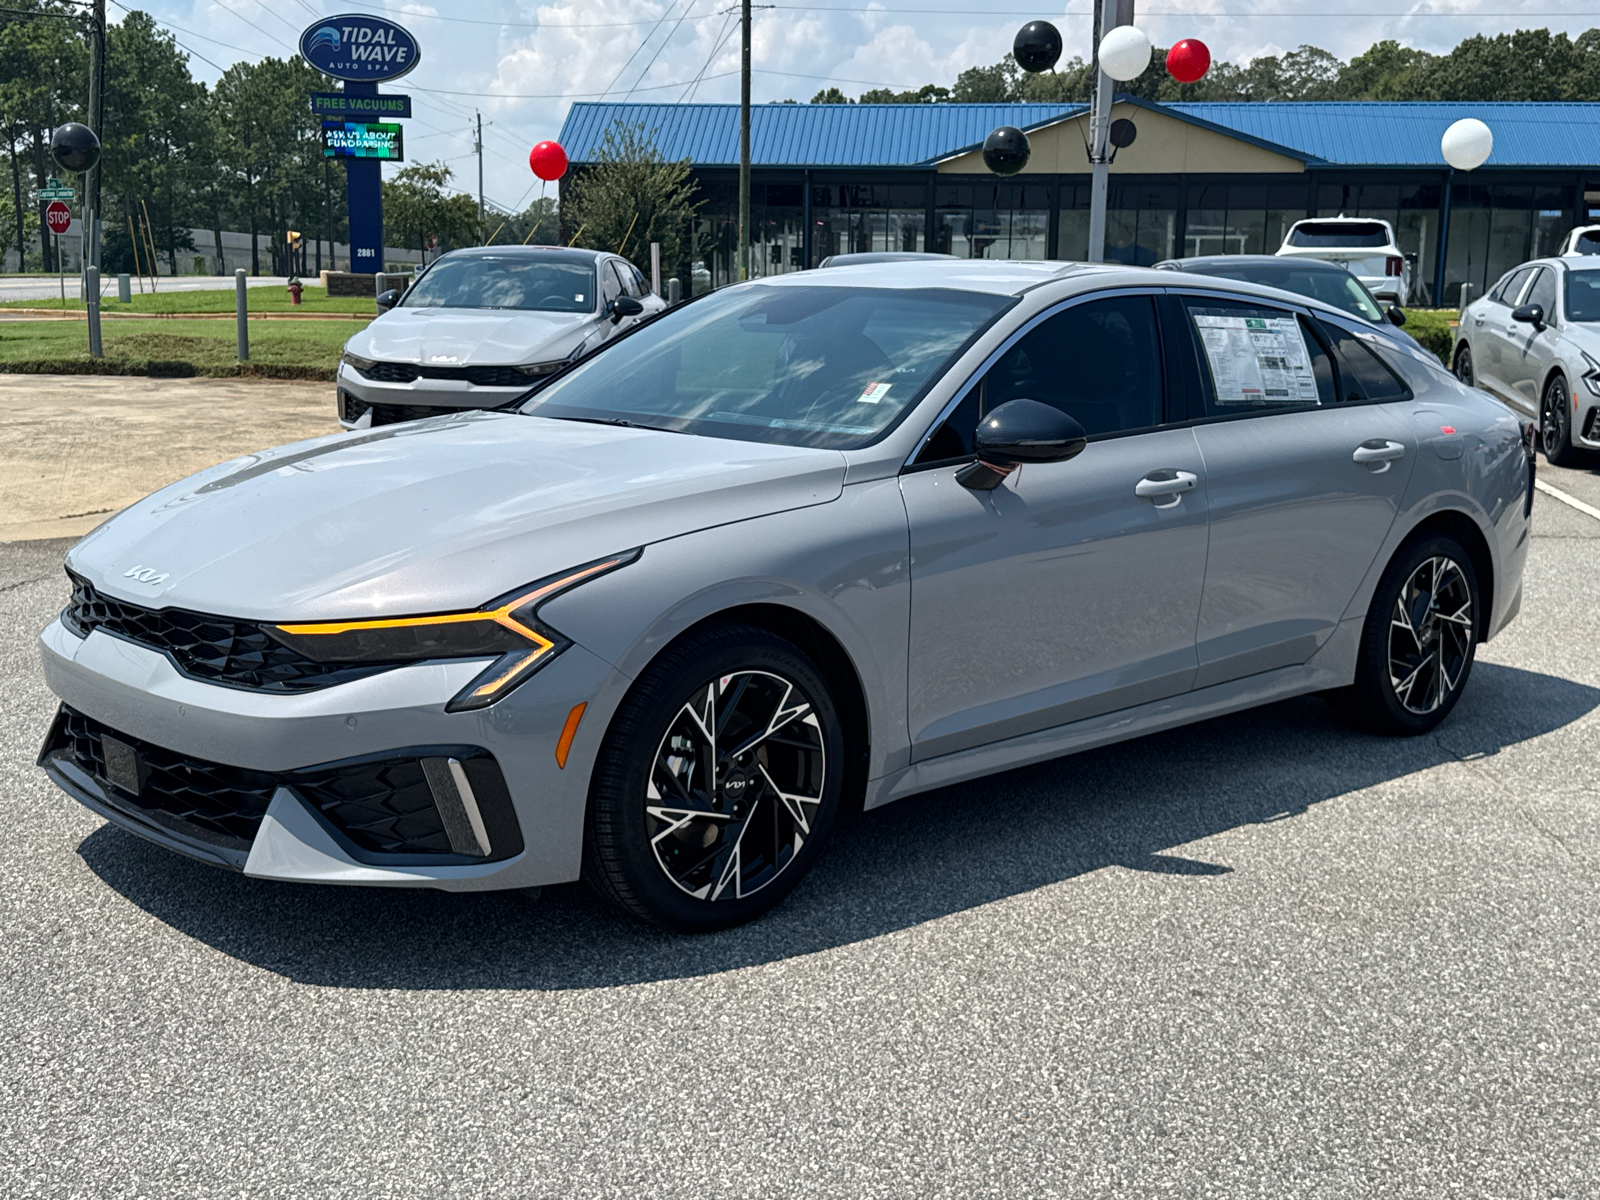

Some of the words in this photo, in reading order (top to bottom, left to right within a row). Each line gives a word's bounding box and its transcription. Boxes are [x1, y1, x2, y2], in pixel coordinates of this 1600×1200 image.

[342, 27, 396, 45] TIDAL
[351, 45, 408, 63] WAVE
[329, 62, 359, 70] AUTO
[367, 64, 389, 72] SPA
[316, 97, 347, 109] FREE
[348, 98, 405, 111] VACUUMS
[325, 130, 345, 139] ASK
[362, 131, 396, 140] ABOUT
[48, 211, 70, 224] STOP
[357, 248, 375, 258] 2881
[123, 564, 170, 586] KIA
